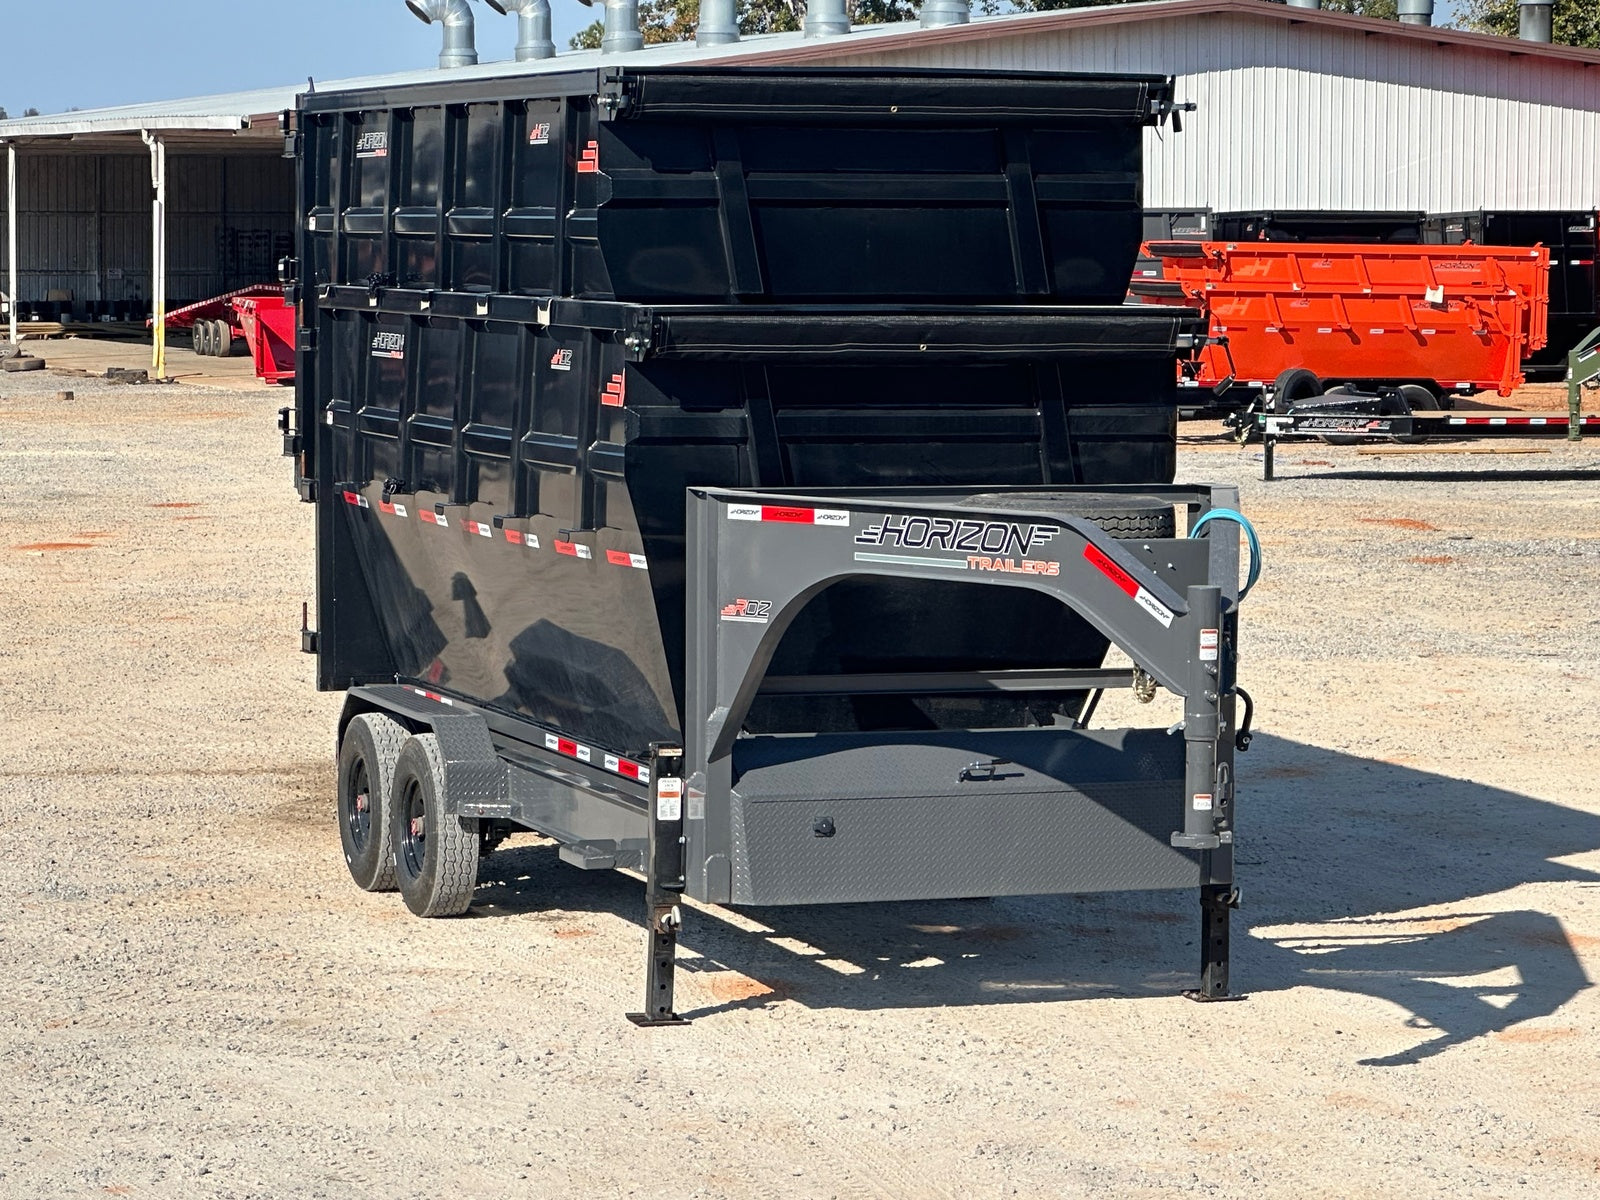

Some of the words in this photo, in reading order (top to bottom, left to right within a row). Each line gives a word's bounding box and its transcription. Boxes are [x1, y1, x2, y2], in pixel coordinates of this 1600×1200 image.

[868, 514, 1047, 557] HORIZON
[966, 556, 1060, 576] TRAILERS
[727, 598, 772, 618] RDZ
